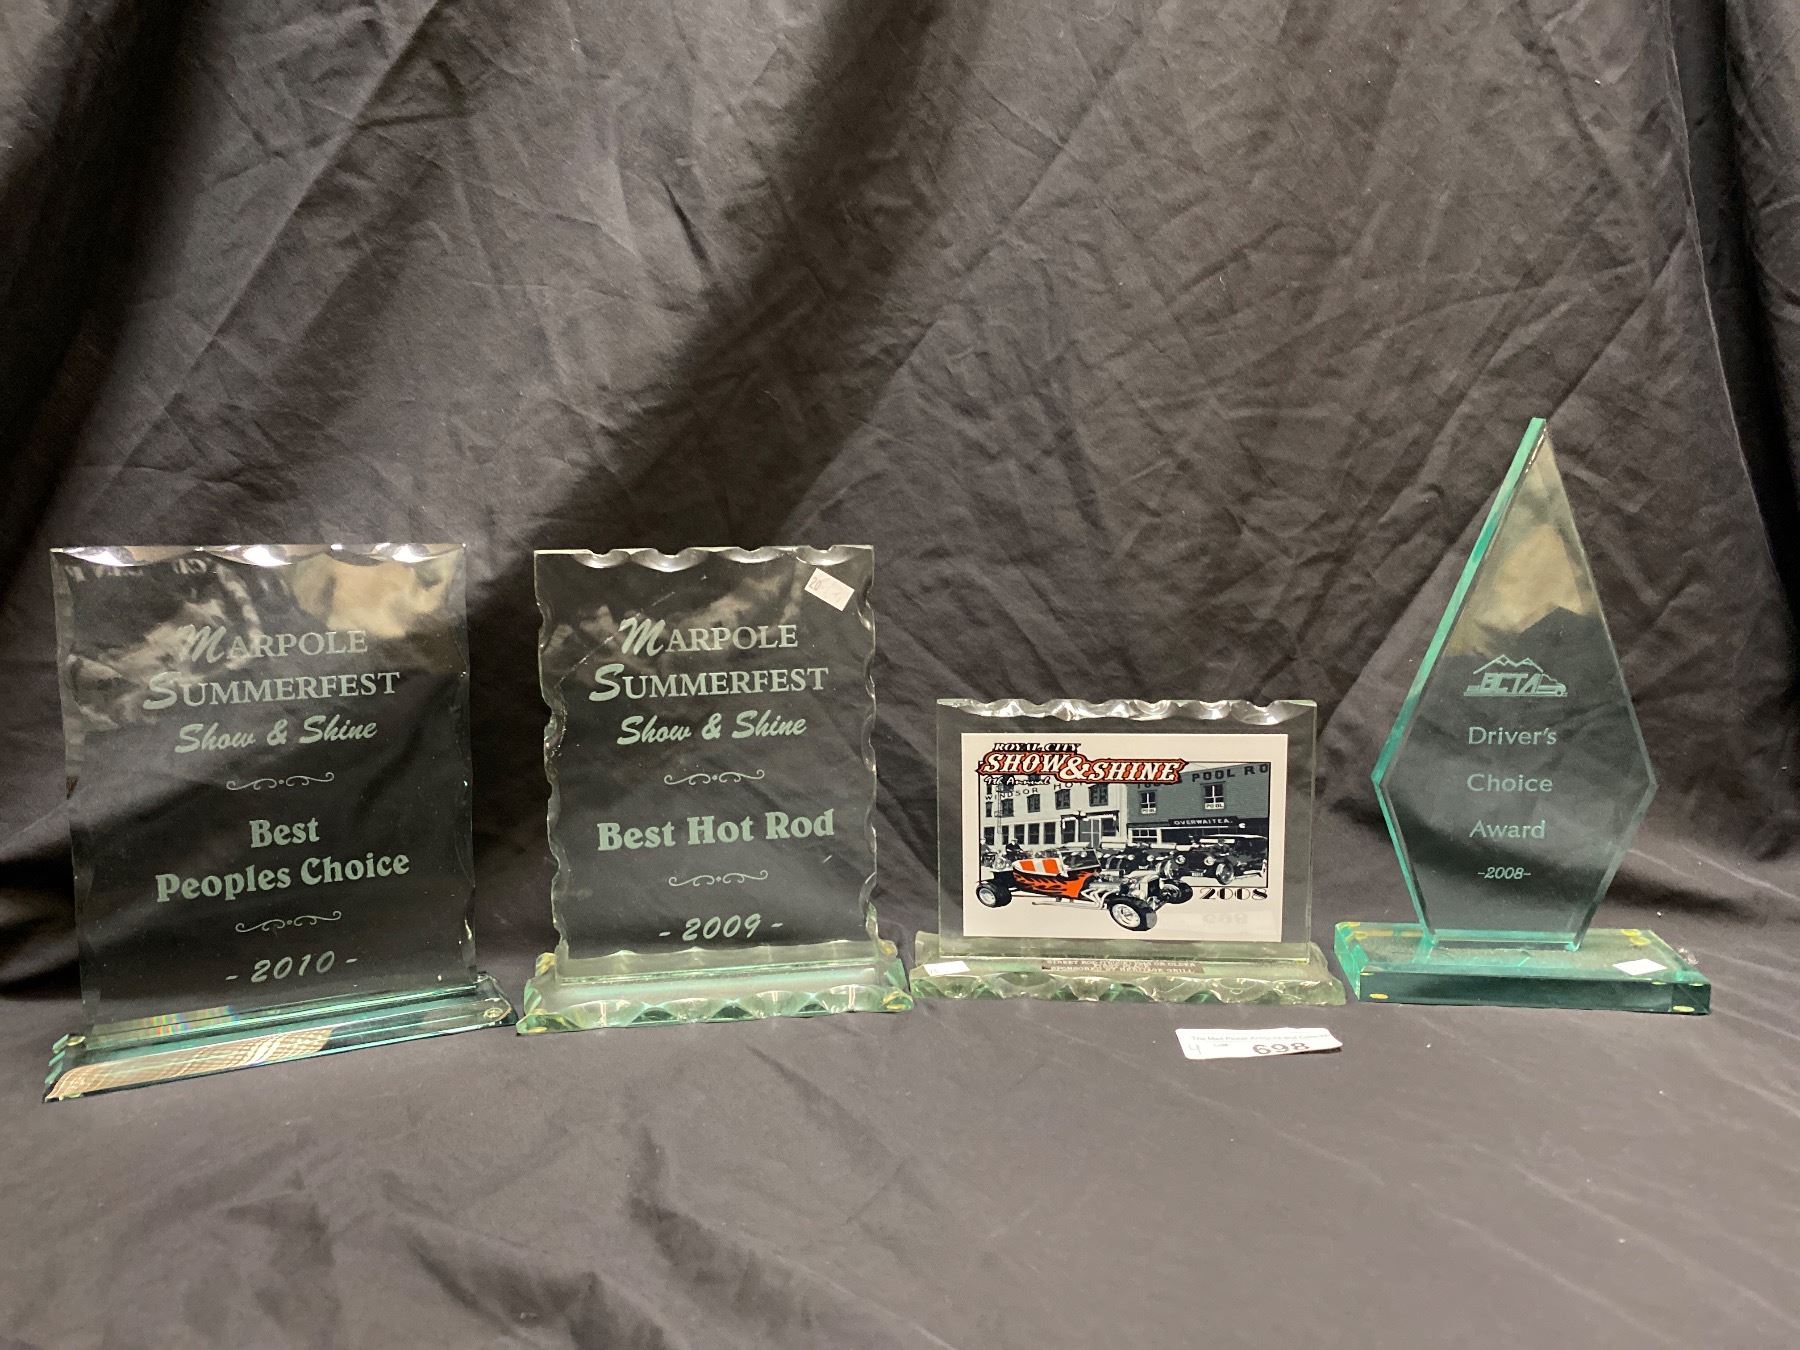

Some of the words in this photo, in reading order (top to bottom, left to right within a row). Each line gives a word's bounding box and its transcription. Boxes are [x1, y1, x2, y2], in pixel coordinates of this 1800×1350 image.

[176, 624, 367, 664] MARPOLE
[618, 616, 798, 657] MARPOLE
[143, 670, 400, 710] SUMMERFEST
[588, 663, 829, 702] SUMMERFEST
[174, 723, 255, 754] Show
[266, 718, 287, 746] &
[299, 715, 378, 744] Shine
[616, 715, 692, 746] Show
[701, 713, 721, 740] &
[731, 709, 807, 740] Shine
[1468, 727, 1557, 746] Driver's
[1192, 769, 1235, 782] POOL
[1467, 773, 1553, 793] Choice
[985, 787, 1038, 800] WINDSOR
[249, 816, 320, 849] Best
[597, 820, 675, 852] Best
[687, 815, 754, 846] Hot
[765, 809, 835, 841] Rod
[1469, 820, 1546, 840] Award
[155, 864, 291, 903] Peoples
[300, 851, 410, 886] Choice
[682, 913, 761, 942] 2009
[251, 951, 336, 983] 2010
[1252, 1042, 1310, 1055] 698
